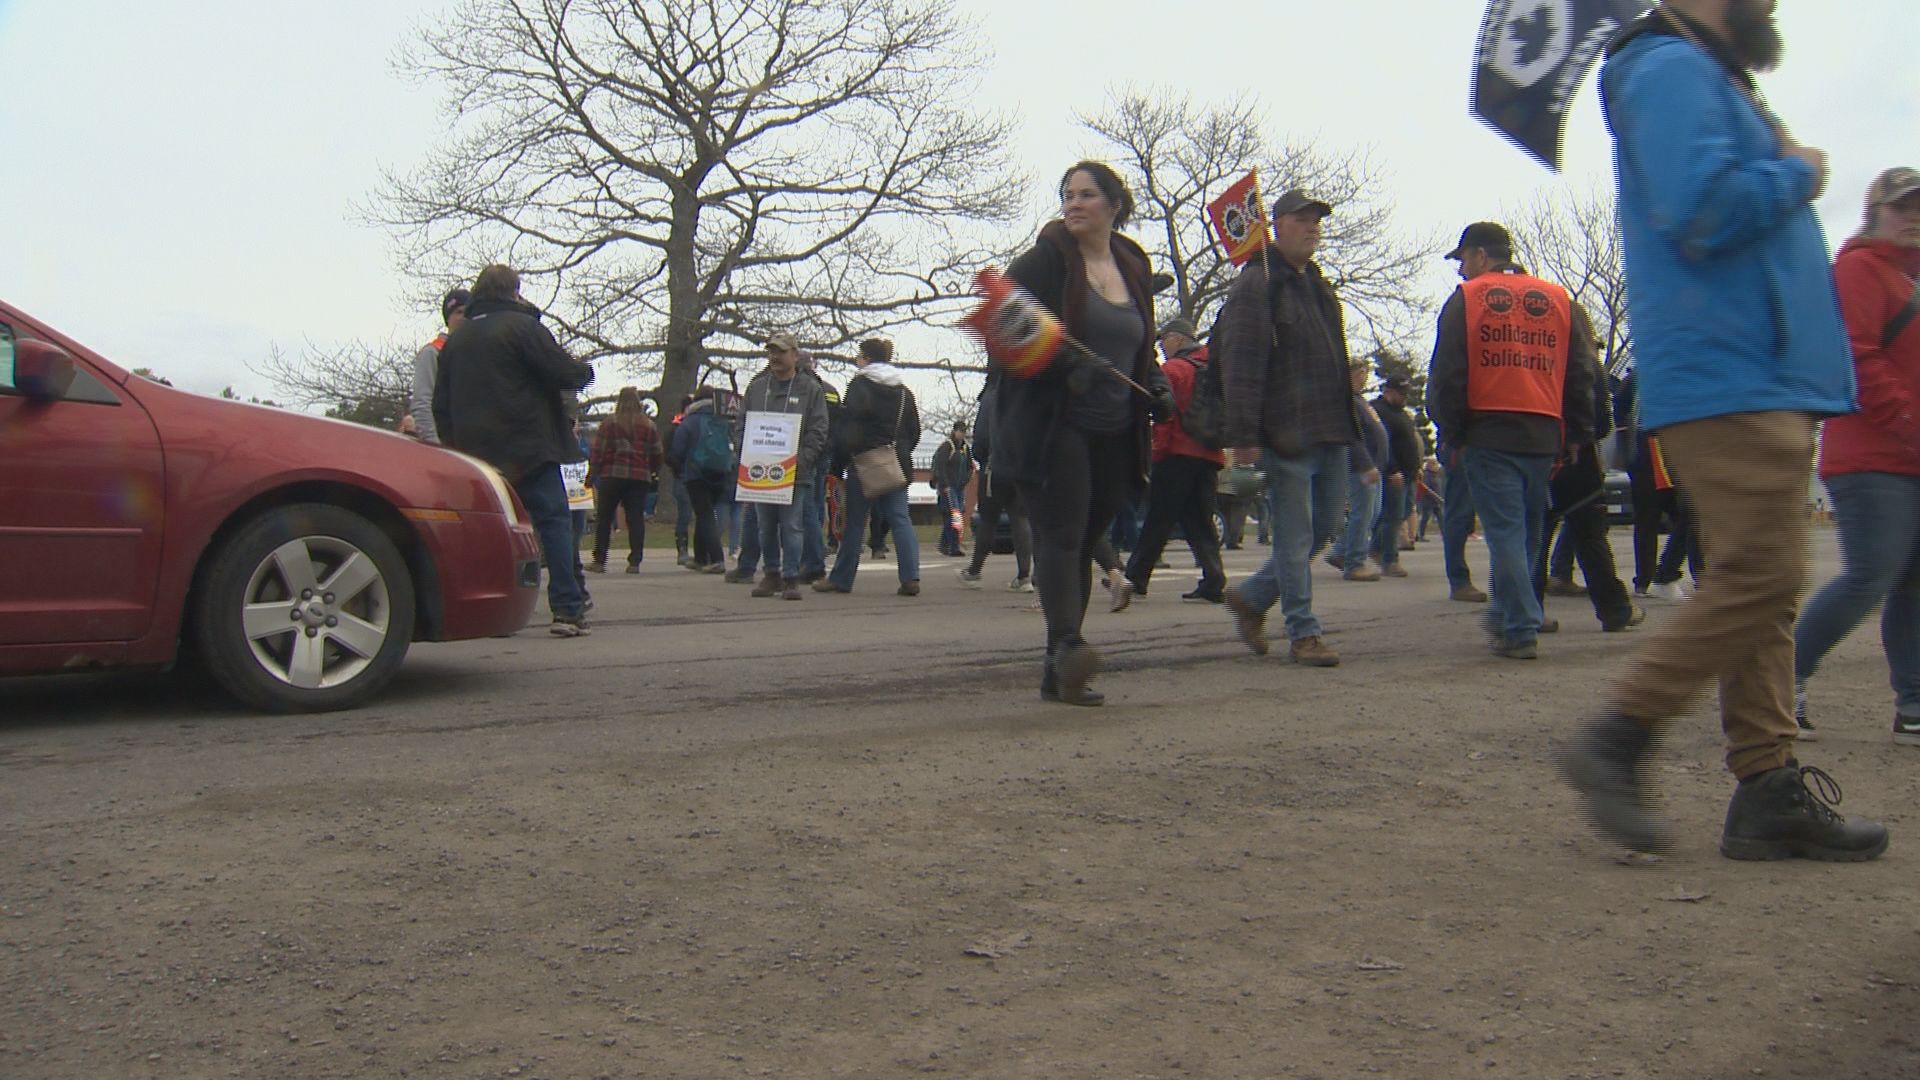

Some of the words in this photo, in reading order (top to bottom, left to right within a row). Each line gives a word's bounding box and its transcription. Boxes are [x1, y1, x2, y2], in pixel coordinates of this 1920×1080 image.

[1488, 295, 1511, 305] AFPC
[1525, 297, 1548, 310] PSAC
[1480, 324, 1556, 348] Solidarité
[1480, 349, 1554, 376] Solidarity
